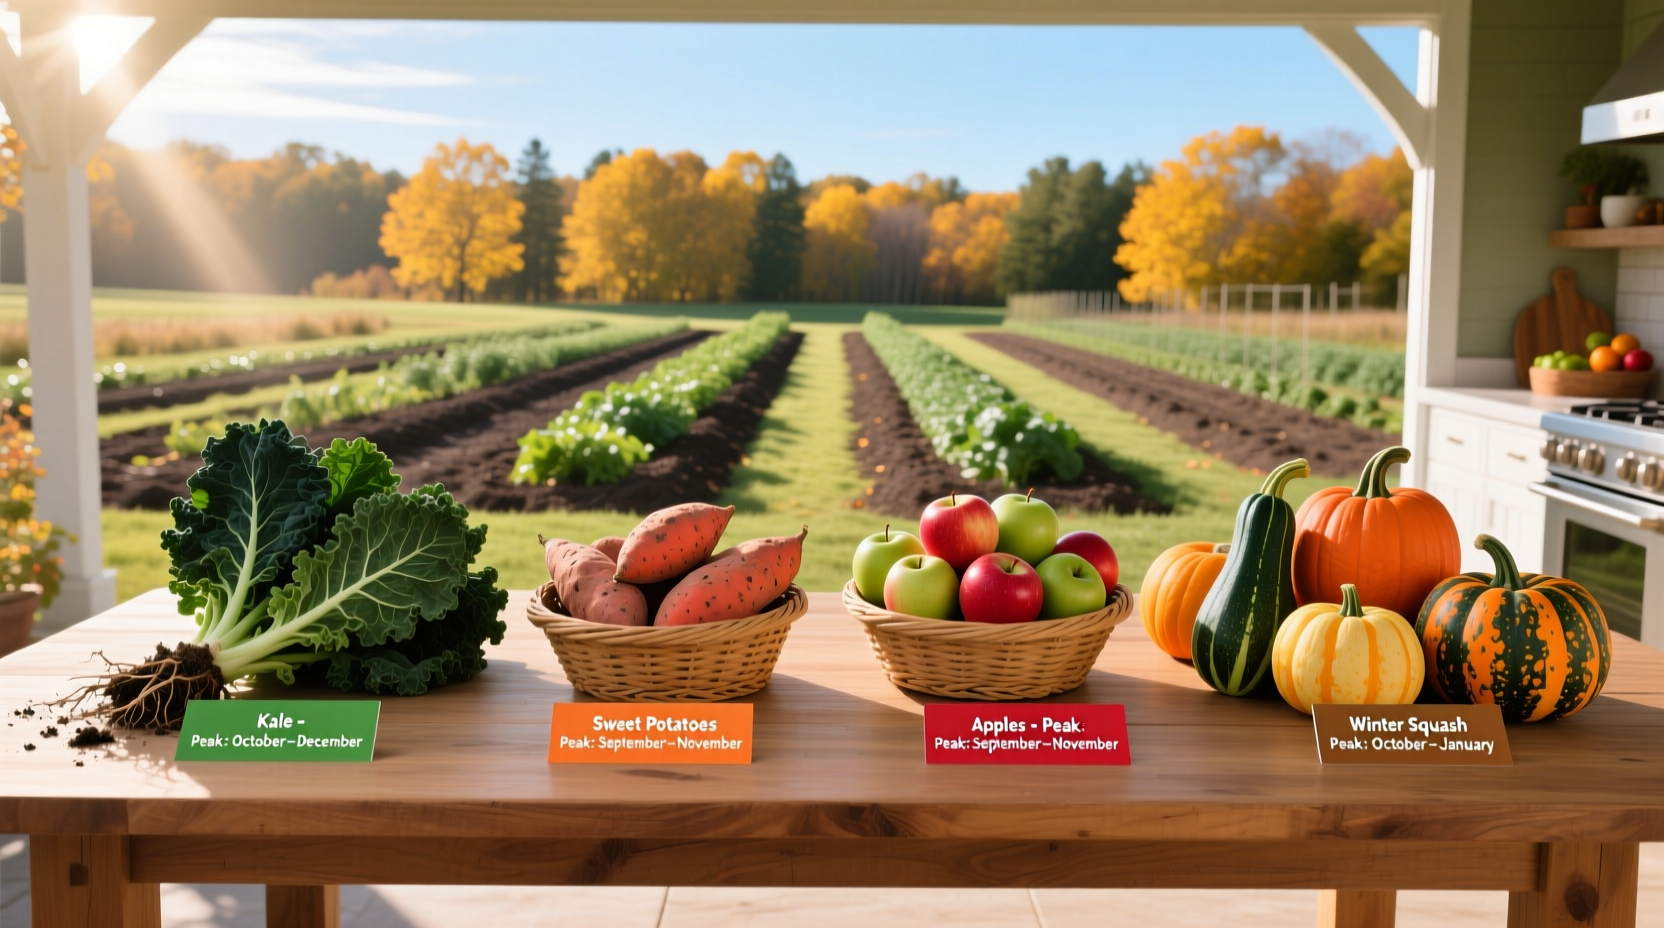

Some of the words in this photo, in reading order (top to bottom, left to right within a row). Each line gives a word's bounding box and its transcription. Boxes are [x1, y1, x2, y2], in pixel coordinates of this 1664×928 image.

[257, 712, 293, 729] Kale
[592, 715, 641, 732] Sweet
[646, 715, 718, 732] Potatoes
[971, 715, 1026, 737] Apples
[1349, 715, 1404, 732] Winter
[1408, 715, 1468, 737] Squash
[191, 733, 229, 747] Peak:
[559, 735, 596, 749] Peak:
[934, 736, 970, 750] Peak:
[1330, 736, 1368, 750] Peak:
